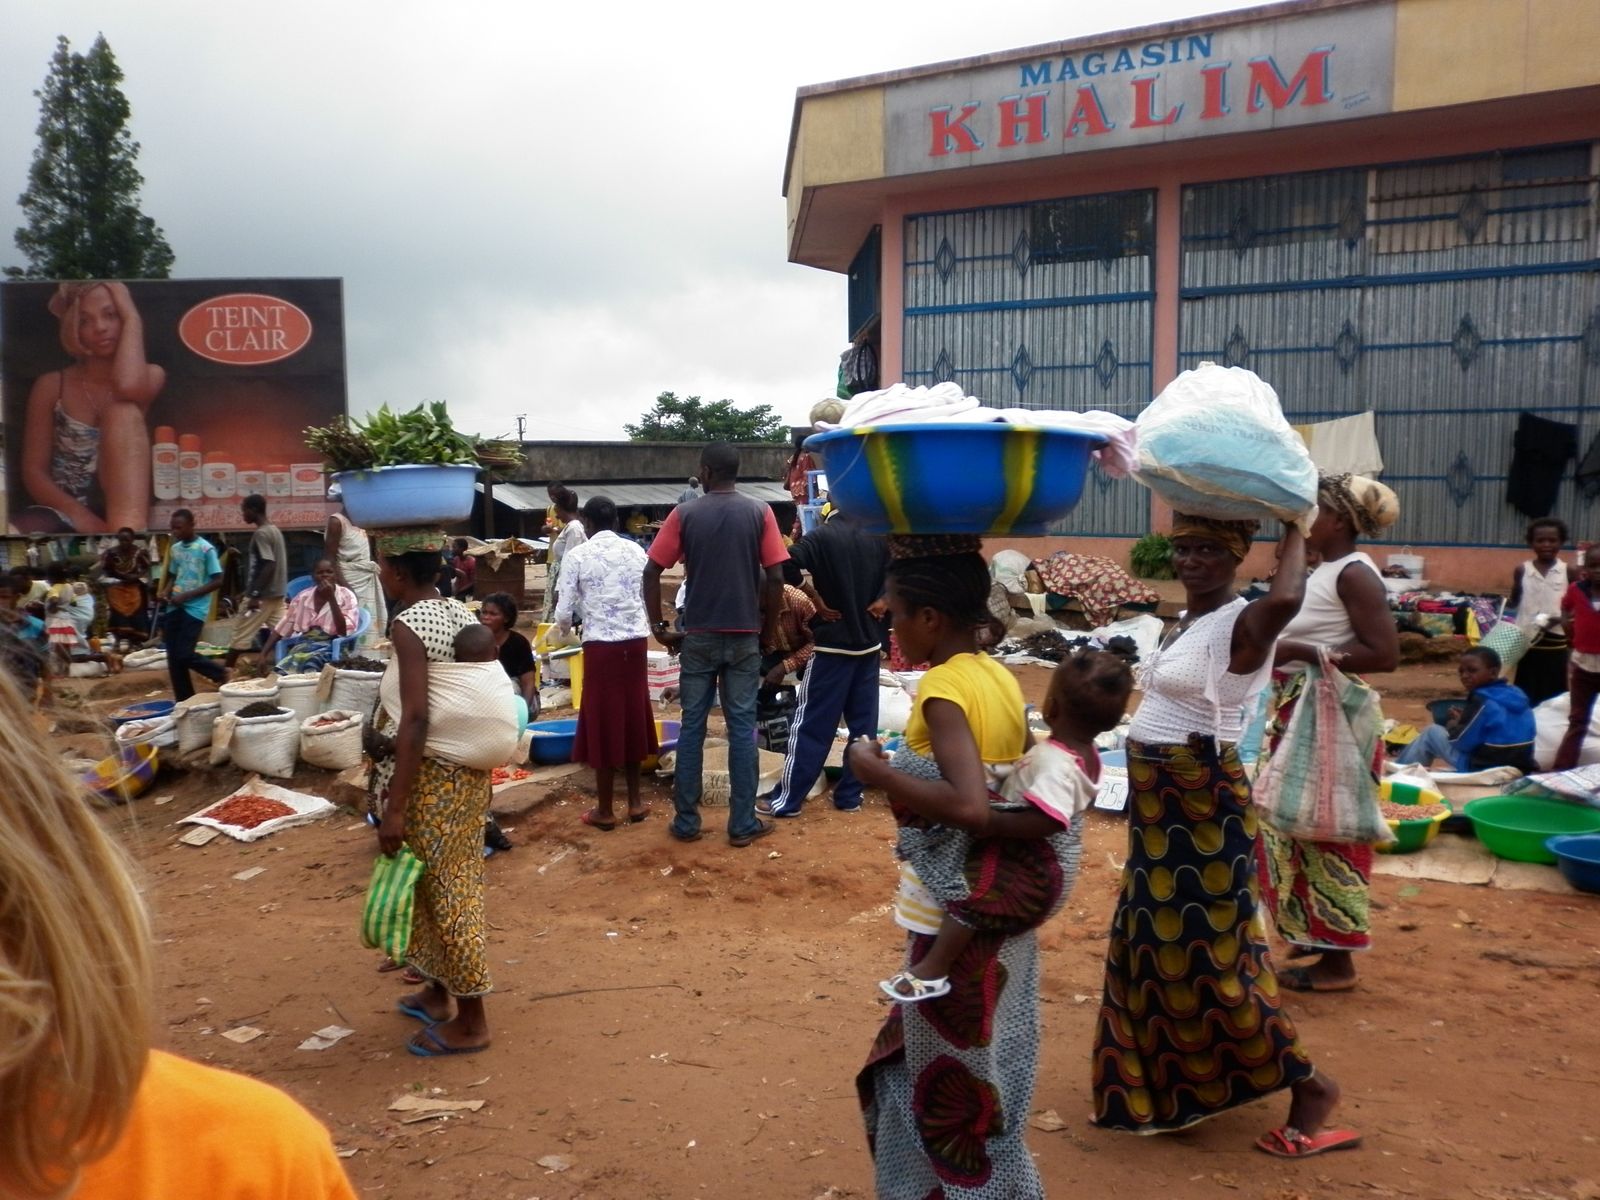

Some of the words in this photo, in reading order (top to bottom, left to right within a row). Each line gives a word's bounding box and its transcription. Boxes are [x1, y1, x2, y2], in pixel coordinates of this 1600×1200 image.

[1020, 33, 1213, 87] MAGASIN
[928, 43, 1336, 156] KHALIM
[206, 306, 286, 328] TEINT
[205, 329, 289, 352] CLAIR
